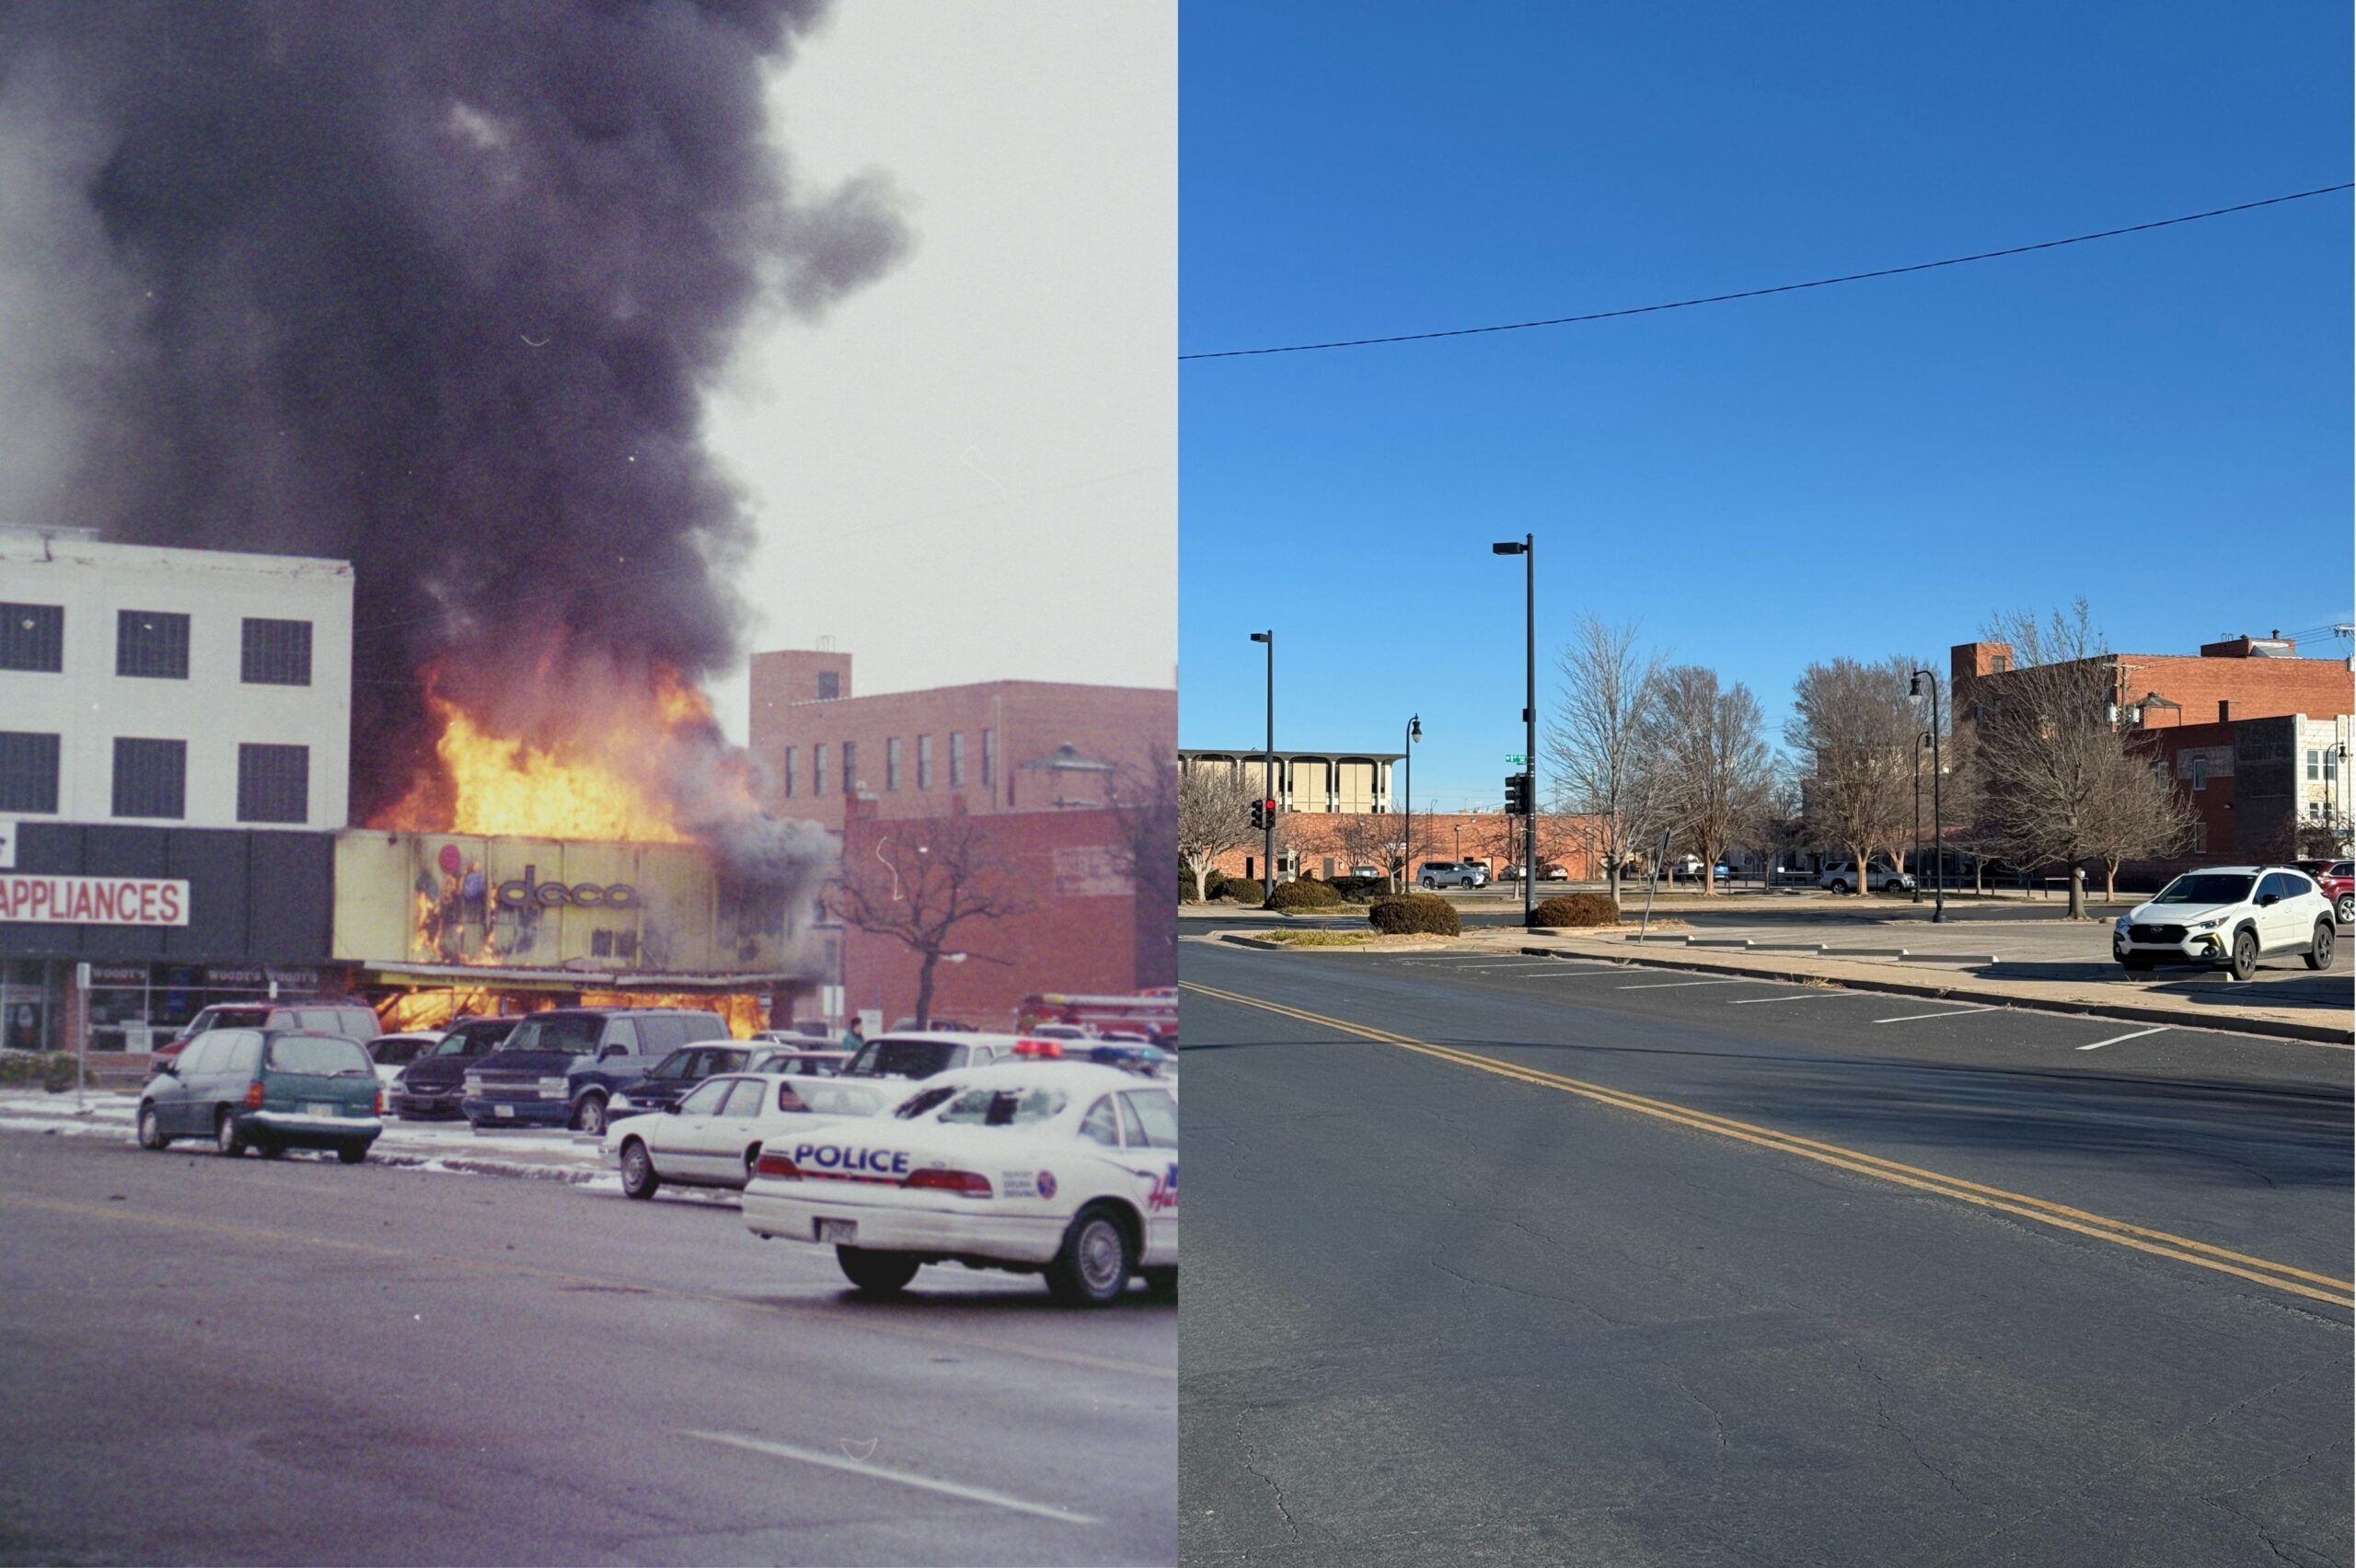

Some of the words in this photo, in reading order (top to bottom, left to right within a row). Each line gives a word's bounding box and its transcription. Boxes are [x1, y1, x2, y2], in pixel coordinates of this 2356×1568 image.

[0, 879, 179, 922] APPLIANCES
[498, 864, 637, 909] deco
[794, 1143, 911, 1174] POLICE
